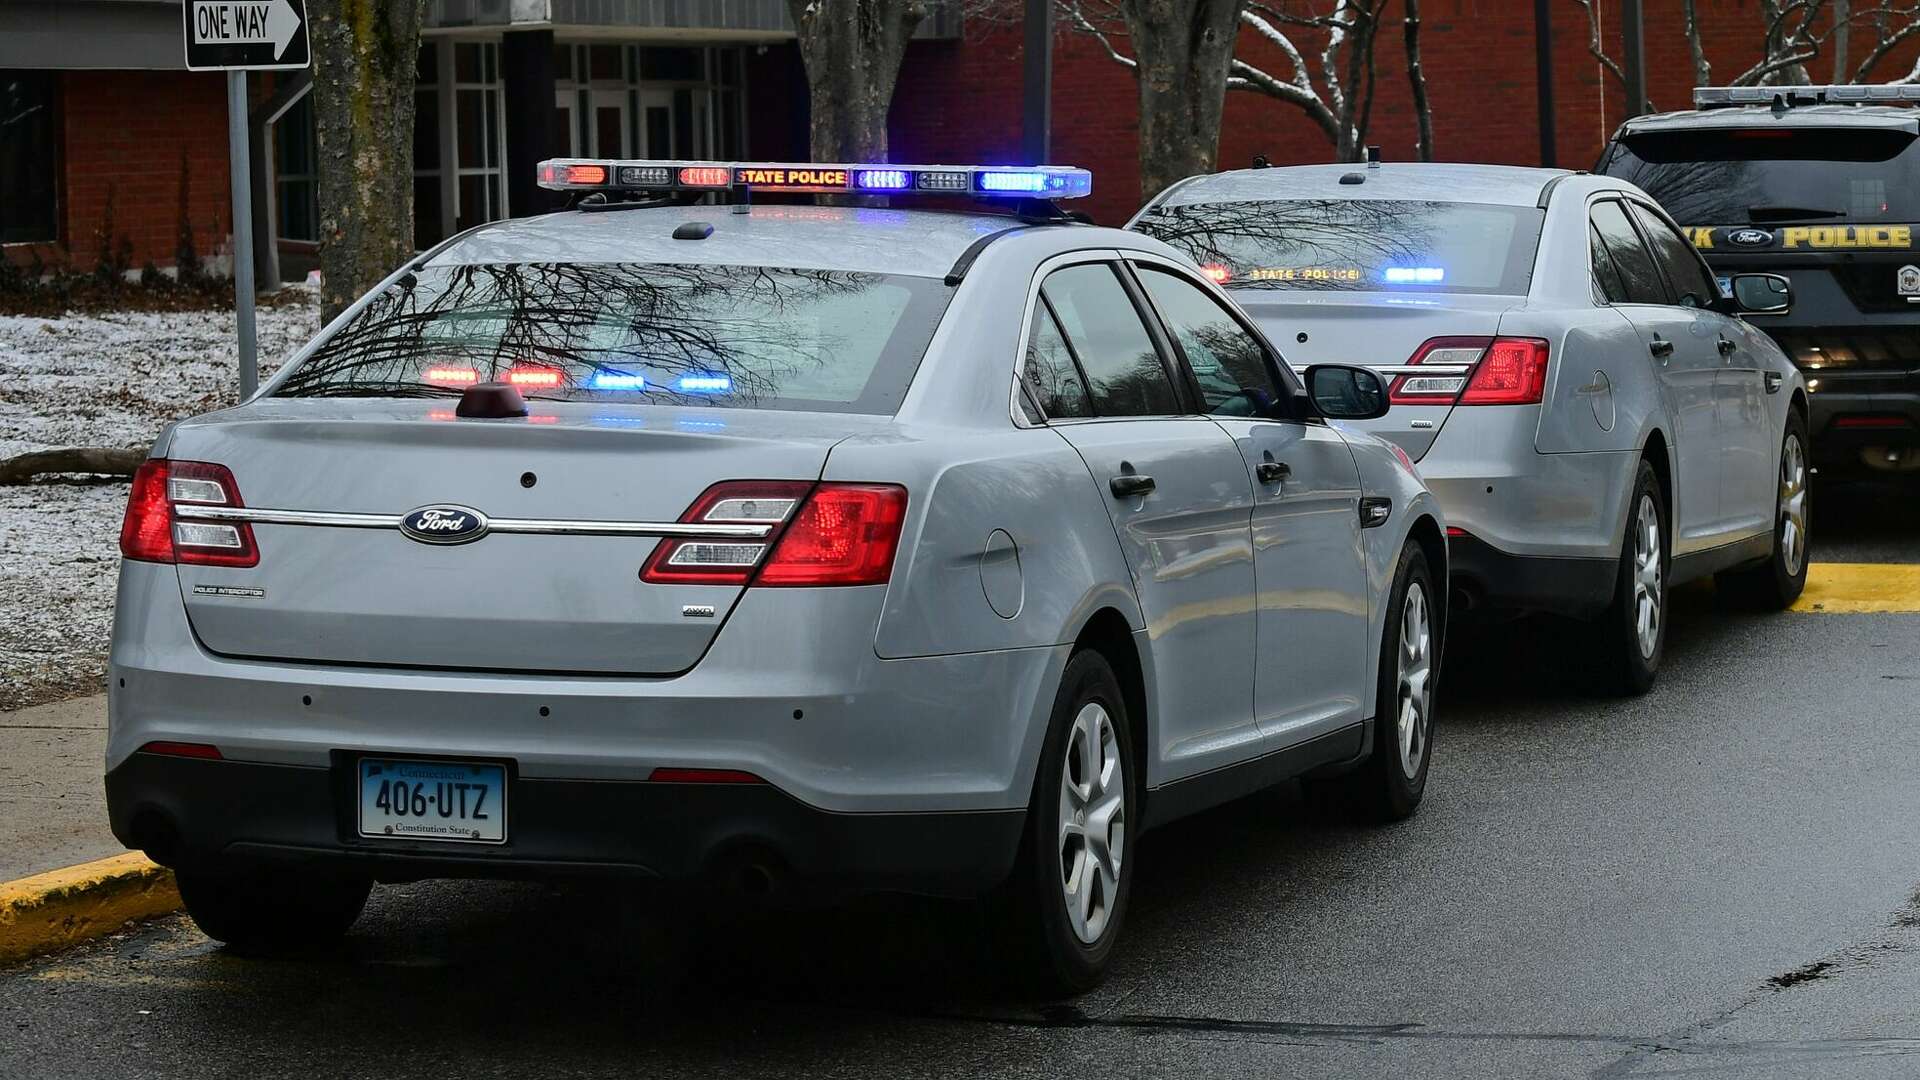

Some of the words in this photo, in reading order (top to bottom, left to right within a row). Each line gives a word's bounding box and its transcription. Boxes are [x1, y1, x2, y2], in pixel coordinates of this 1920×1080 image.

[198, 5, 230, 39] ONE
[234, 5, 270, 39] WAY
[738, 170, 784, 183] STATE
[788, 171, 845, 185] POLICE
[1737, 231, 1763, 243] Ford
[1783, 226, 1912, 248] POLICE
[1251, 269, 1295, 280] STATE
[1303, 269, 1356, 280] POLICE
[416, 509, 466, 531] Ford
[395, 822, 447, 834] Constitution
[449, 825, 471, 836] State
